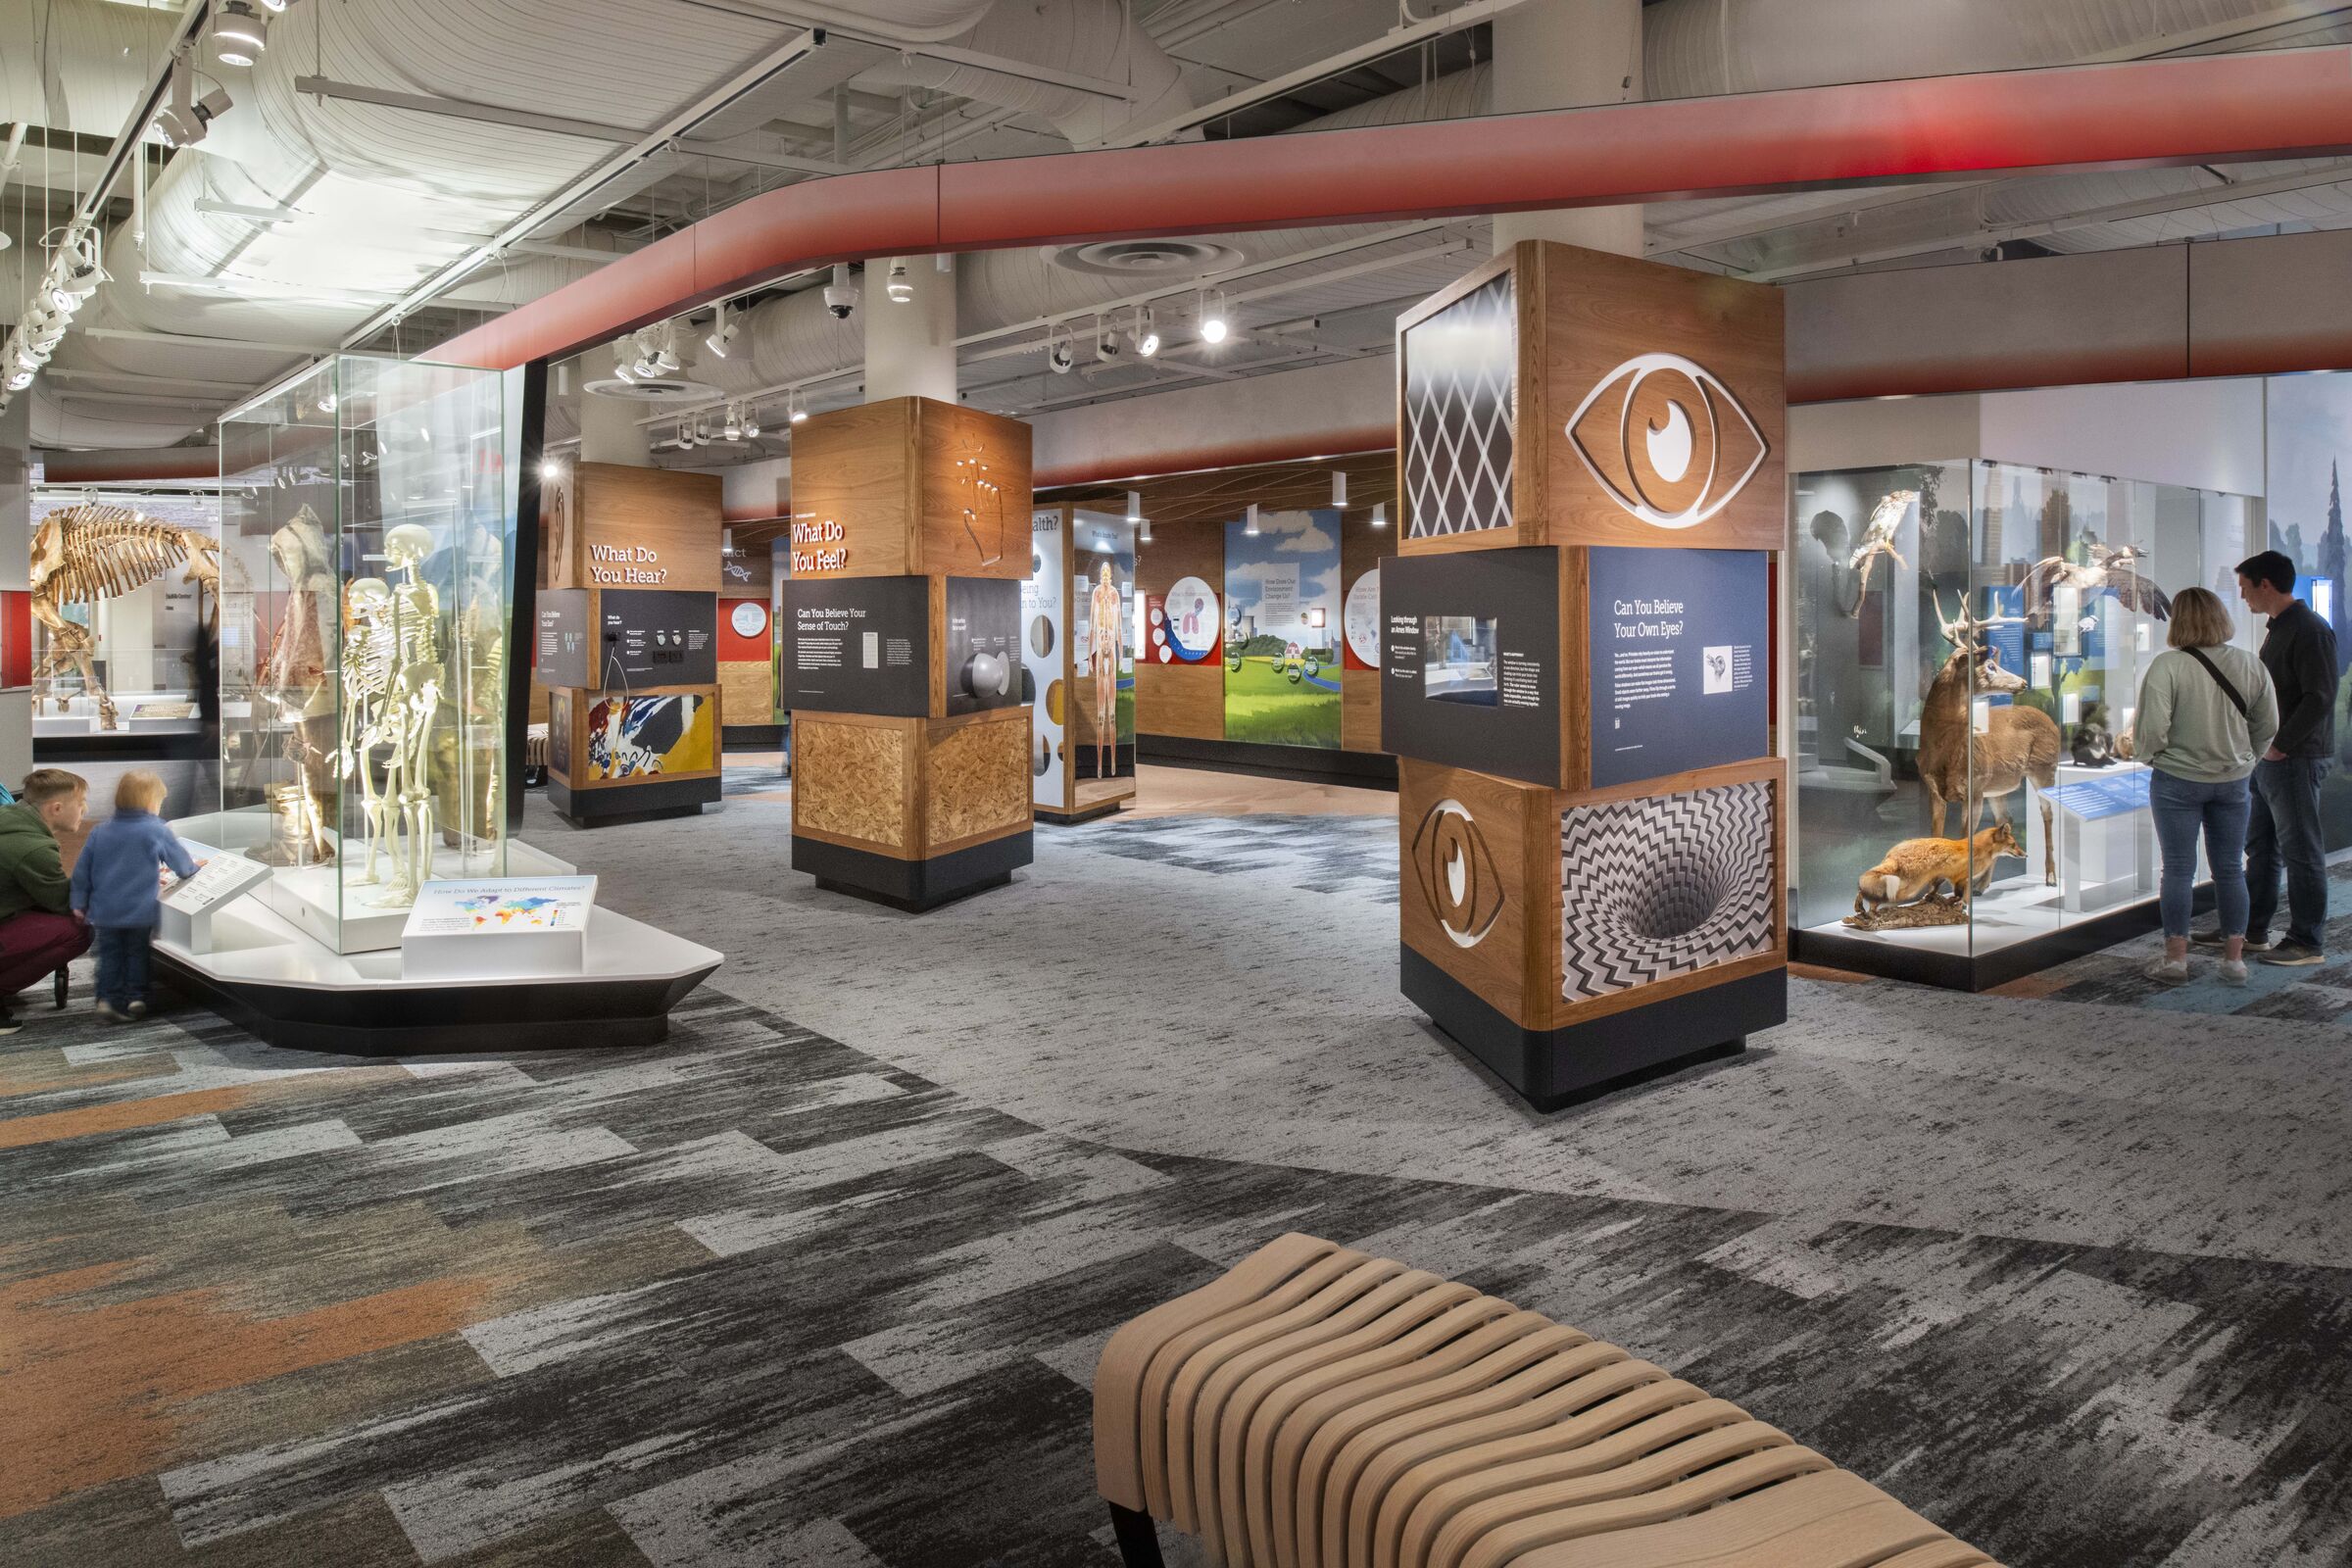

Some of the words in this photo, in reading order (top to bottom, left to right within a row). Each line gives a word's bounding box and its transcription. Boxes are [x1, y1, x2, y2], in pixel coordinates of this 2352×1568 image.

[793, 522, 823, 543] What
[825, 520, 844, 541] Do
[1033, 515, 1058, 531] alth?
[591, 544, 632, 562] What
[636, 547, 658, 563] Do
[793, 551, 814, 571] You
[816, 548, 847, 570] Feel?
[591, 566, 621, 583] You
[625, 567, 667, 584] Hear?
[797, 609, 810, 618] Can
[811, 609, 824, 618] You
[825, 608, 849, 618] Believe
[850, 608, 866, 617] Your
[1614, 600, 1633, 615] Can
[1634, 600, 1652, 615] You
[1653, 599, 1684, 614] Believe
[797, 621, 815, 630] Sense
[816, 621, 824, 630] of
[824, 621, 849, 630] Touch?
[1613, 622, 1637, 638] Your
[1638, 621, 1659, 637] Own
[1660, 620, 1684, 639] Eyes?
